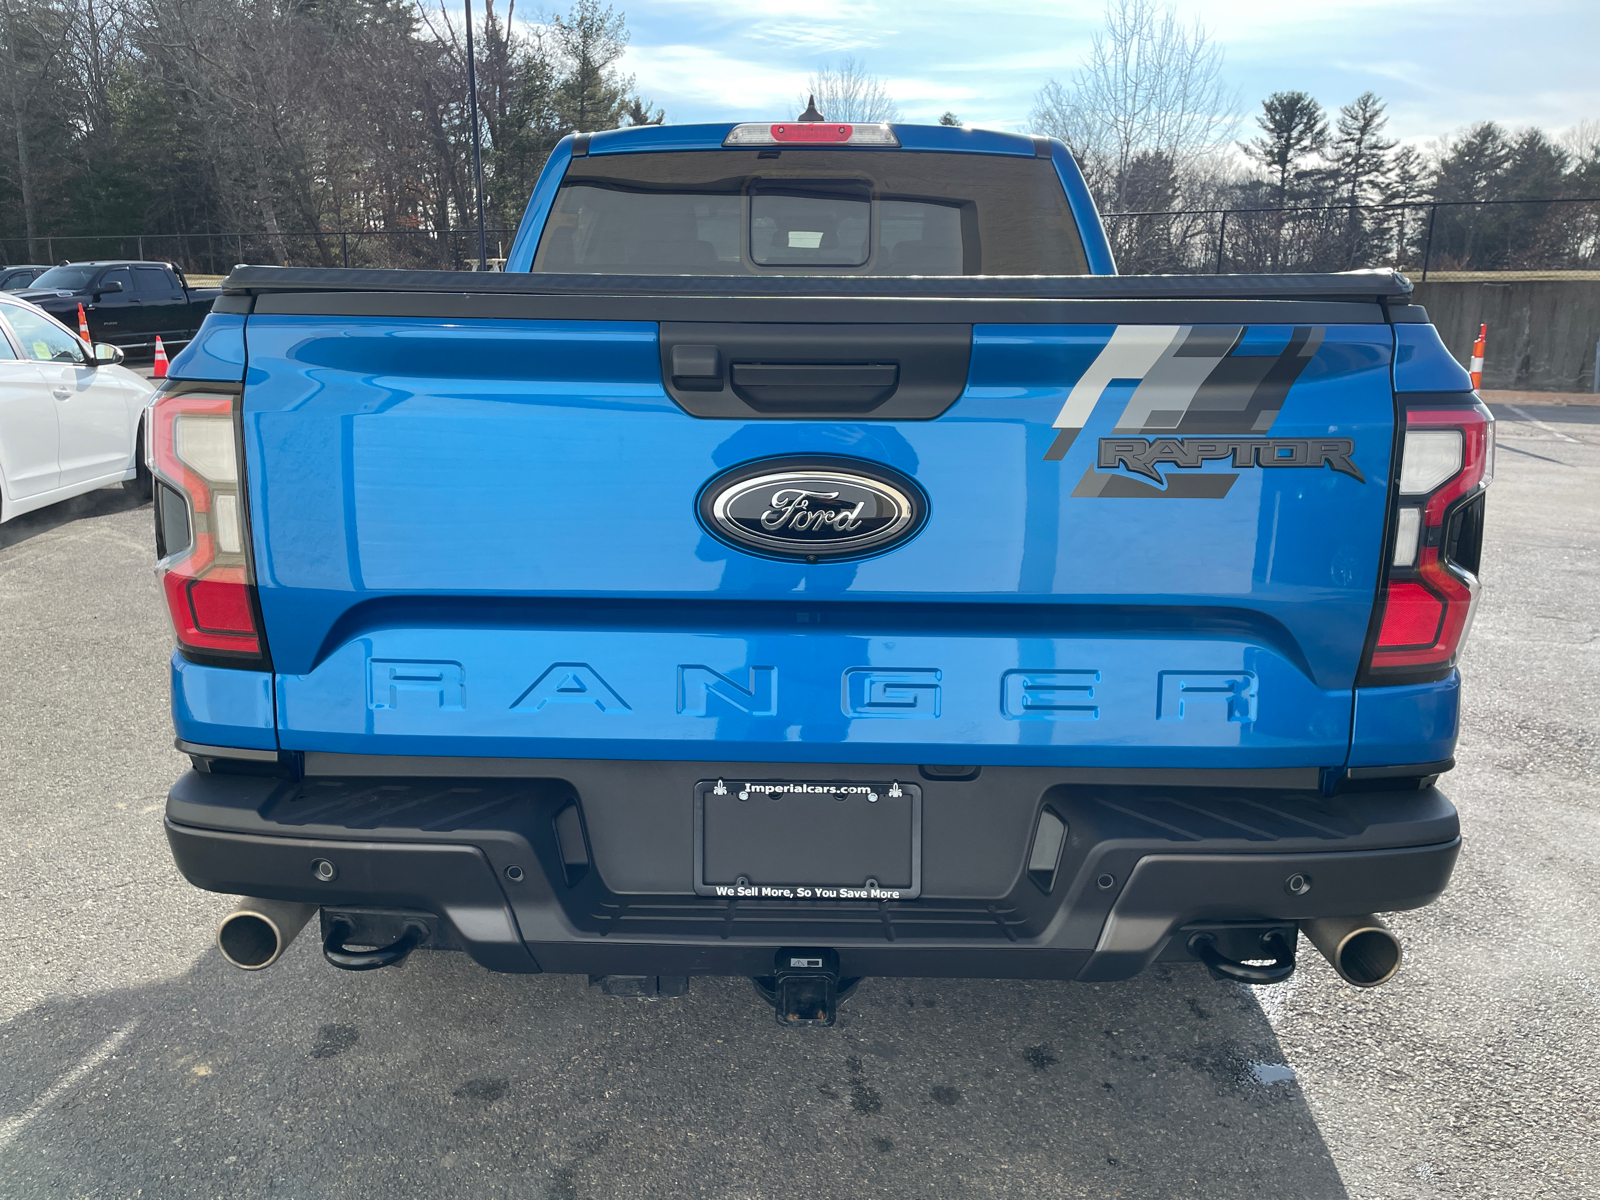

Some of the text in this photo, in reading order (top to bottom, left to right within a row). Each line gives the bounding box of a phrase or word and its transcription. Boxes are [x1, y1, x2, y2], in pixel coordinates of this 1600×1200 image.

[1098, 437, 1366, 485] RAPTOR
[760, 488, 865, 531] Ford
[367, 656, 1259, 722] RANGER
[744, 783, 871, 794] Imperialcars.com
[716, 886, 900, 899] We Sell More, So You Save More
